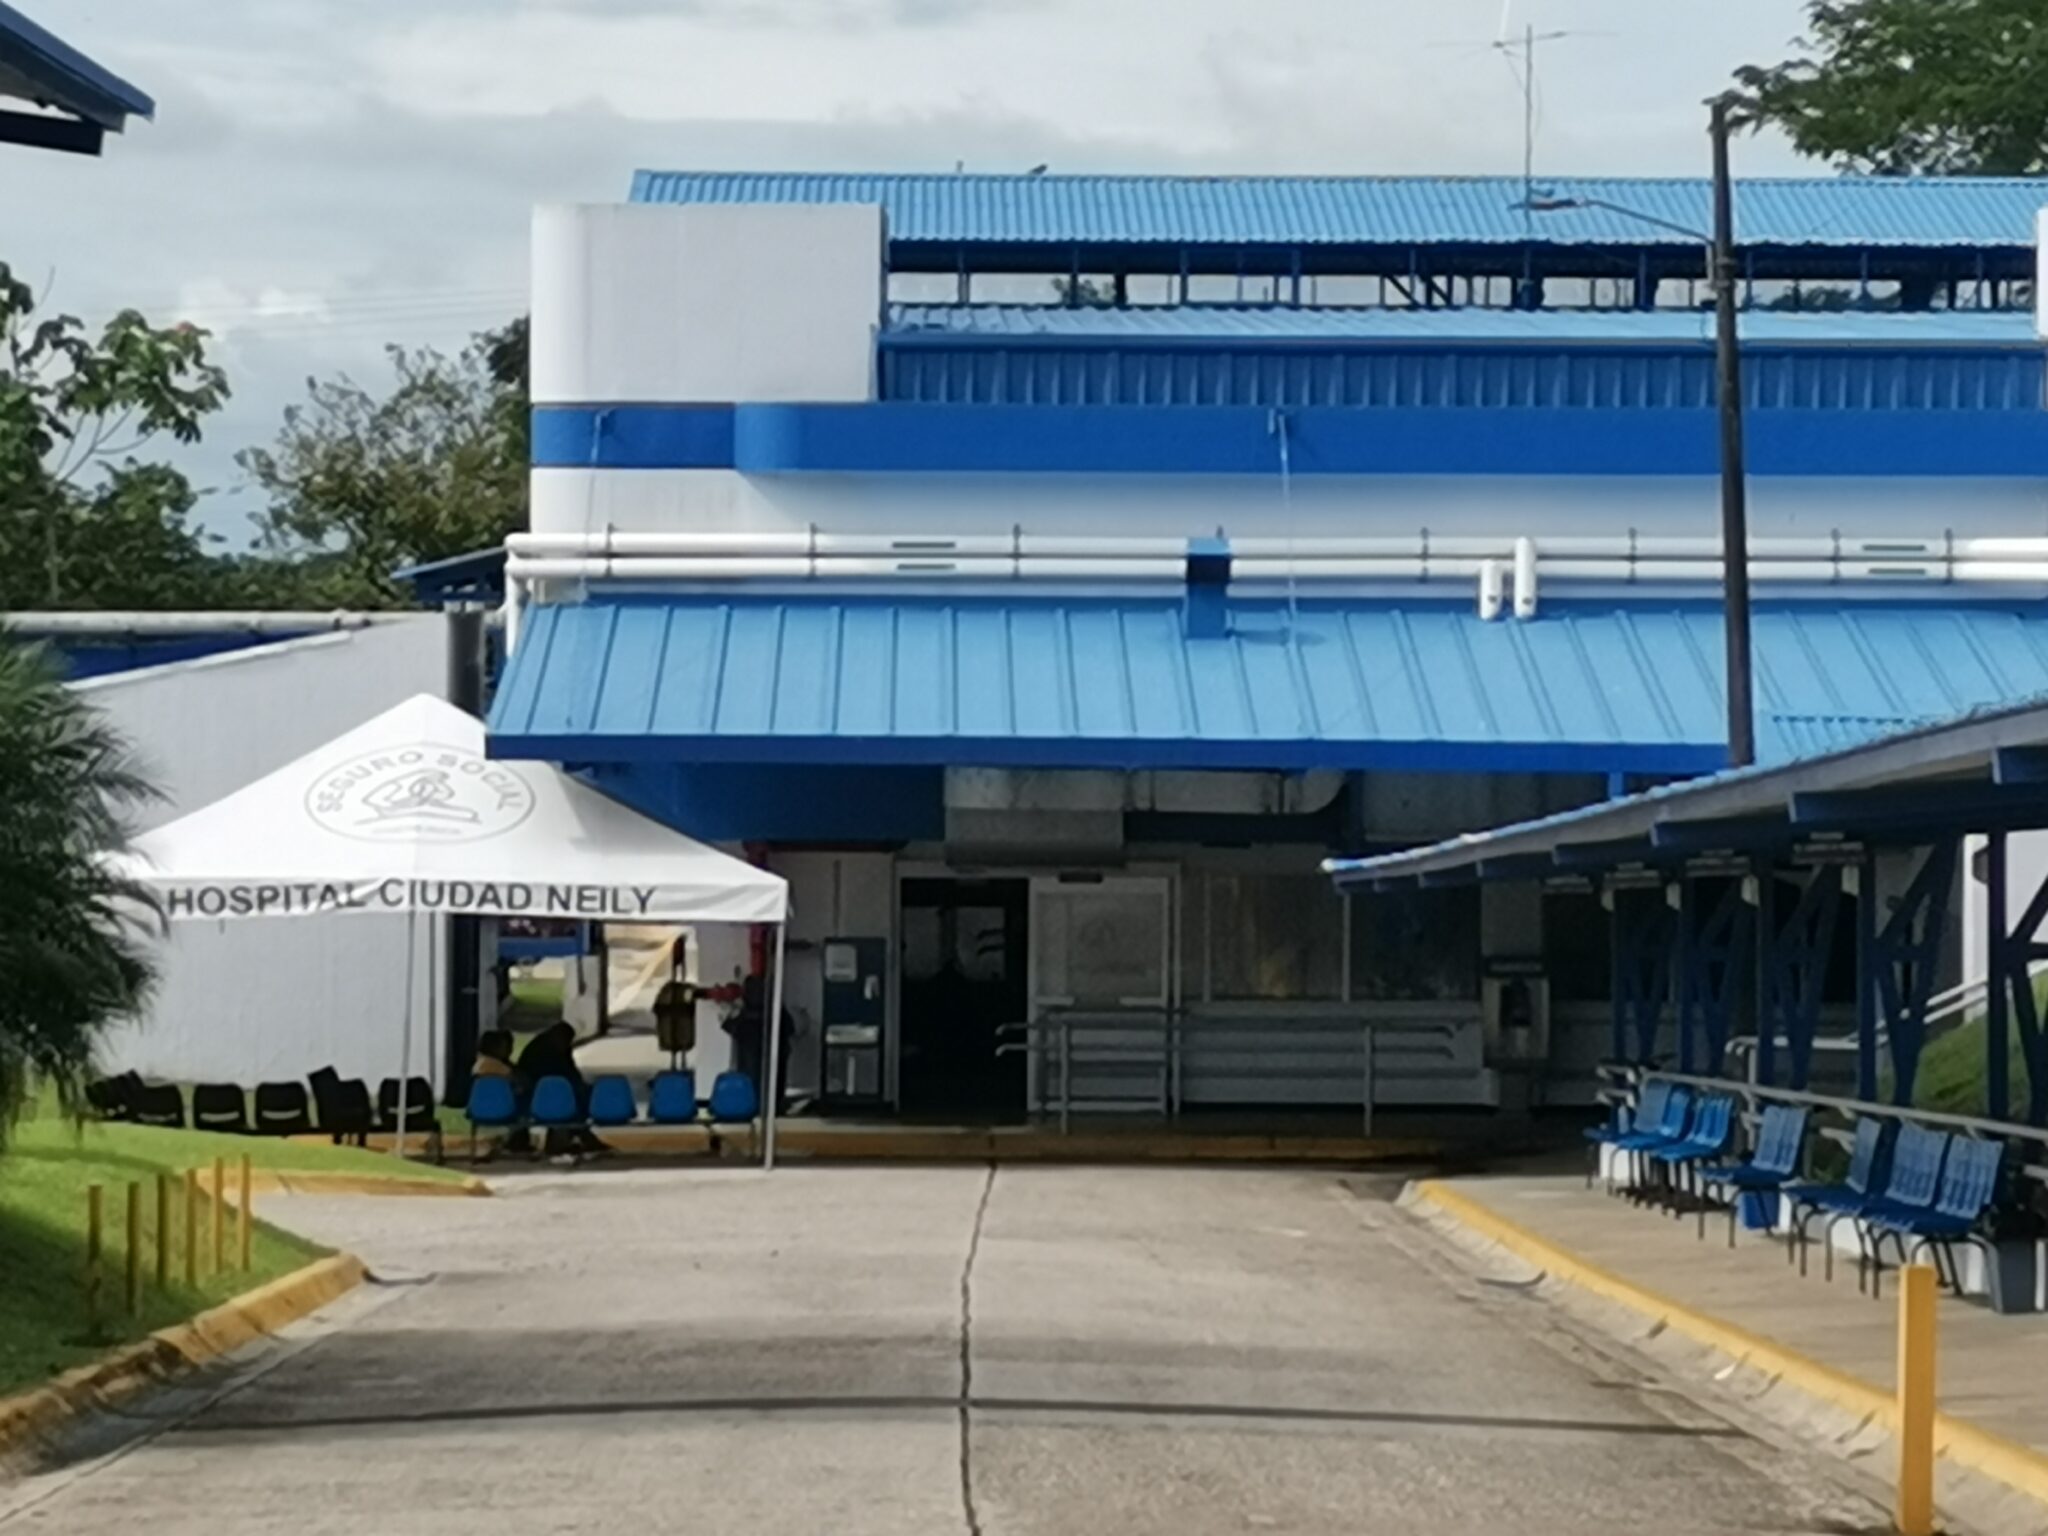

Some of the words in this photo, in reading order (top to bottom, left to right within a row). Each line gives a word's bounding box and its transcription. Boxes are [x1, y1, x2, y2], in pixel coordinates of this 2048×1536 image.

[316, 750, 424, 814] SEGURO
[436, 753, 524, 812] SOCIAL
[168, 883, 367, 916] HOSPITAL
[379, 877, 533, 911] CIUDAD
[547, 884, 657, 915] NEILY
